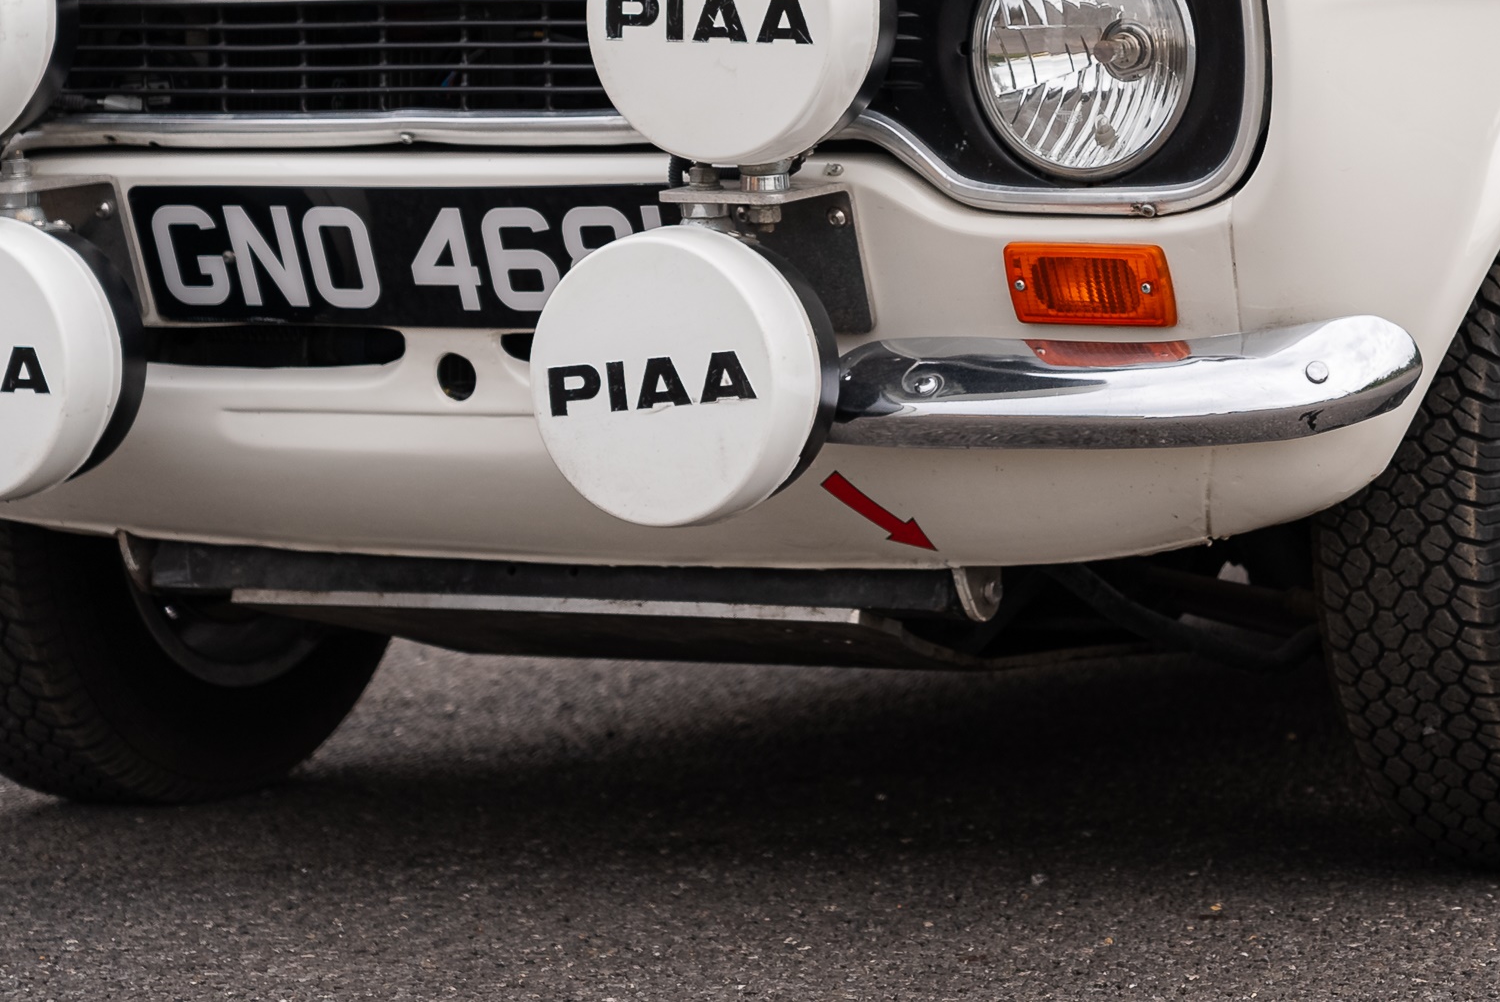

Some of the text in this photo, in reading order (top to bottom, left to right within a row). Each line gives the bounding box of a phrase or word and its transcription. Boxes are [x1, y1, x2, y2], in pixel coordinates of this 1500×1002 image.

[151, 205, 663, 312] GNO 468
[547, 351, 757, 418] PIAA
